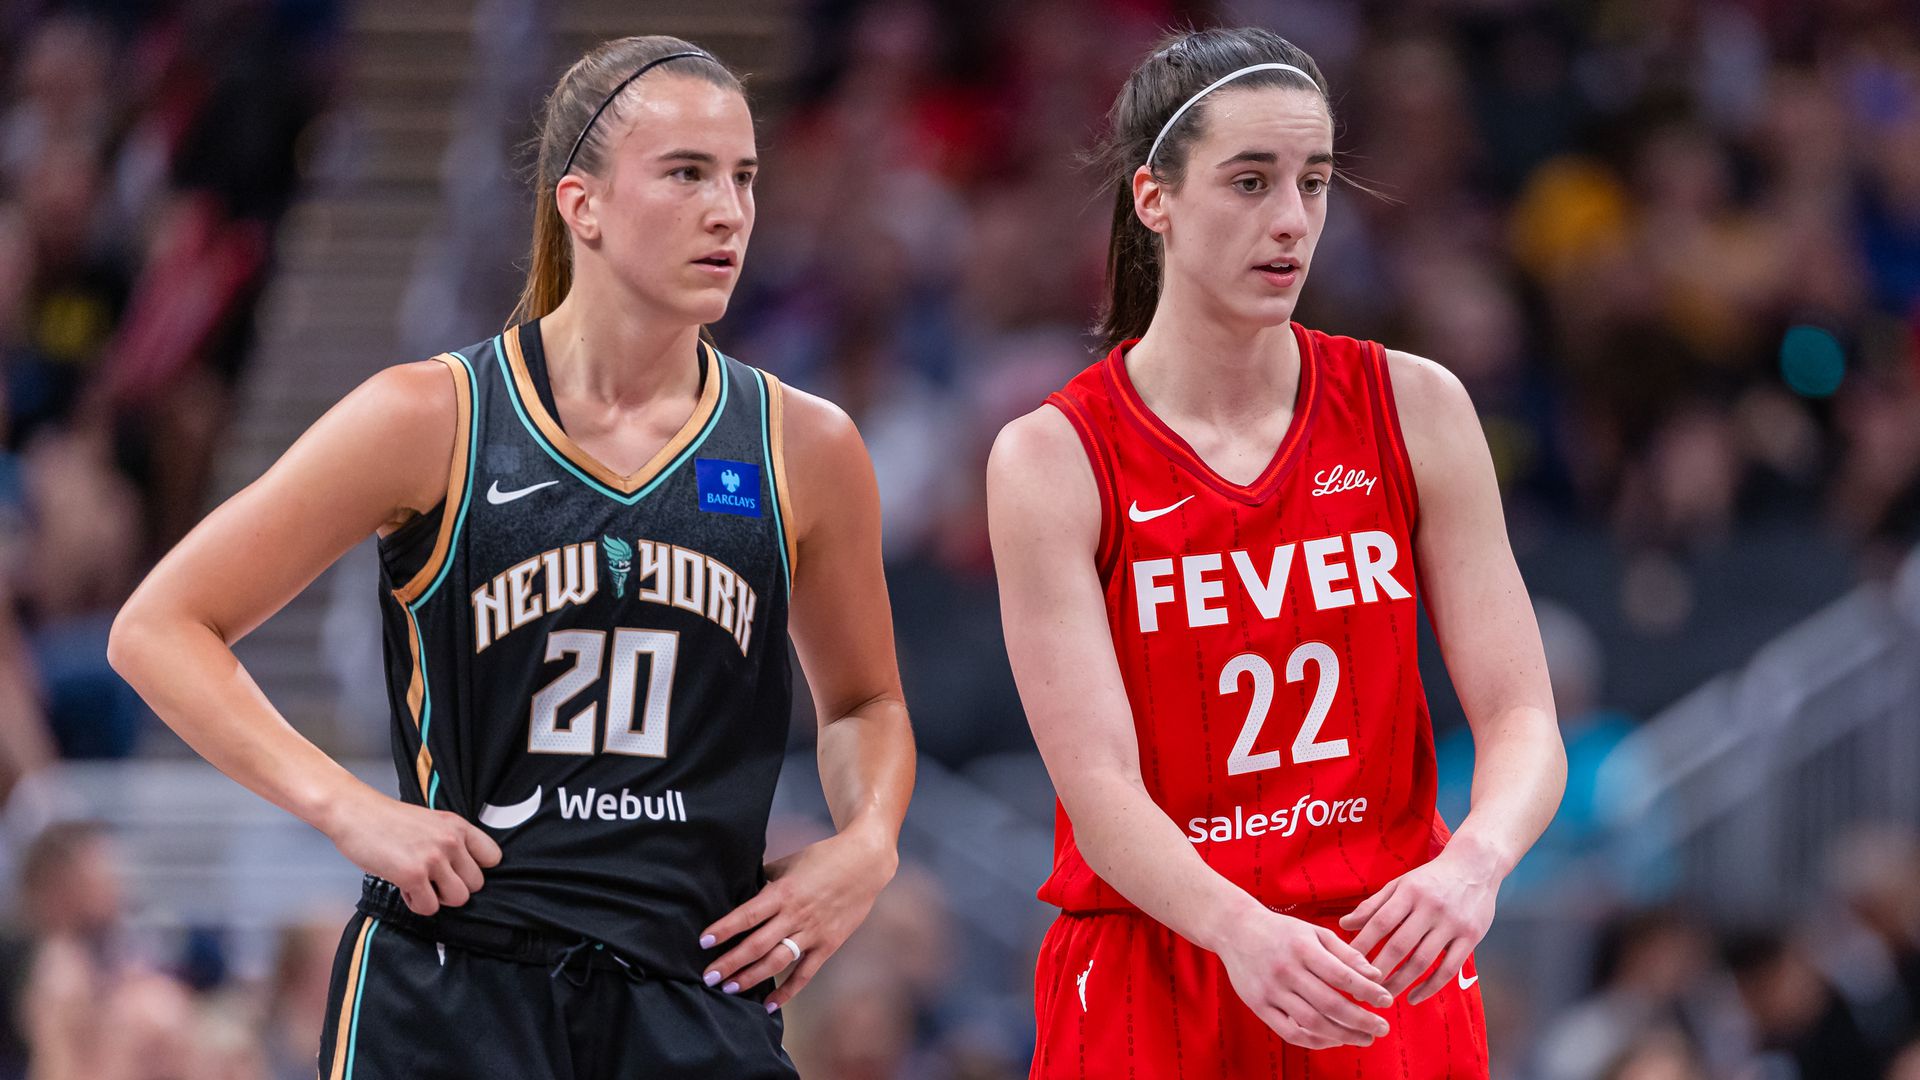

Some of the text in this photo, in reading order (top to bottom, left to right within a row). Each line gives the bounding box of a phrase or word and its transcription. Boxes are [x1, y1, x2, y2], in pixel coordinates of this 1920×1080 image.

[707, 492, 755, 509] BARCLAYS
[1312, 464, 1377, 497] Lilly
[471, 538, 757, 658] NEW YORK
[1132, 530, 1412, 633] FEVER
[527, 626, 680, 758] 20
[1218, 641, 1350, 776] 22
[557, 786, 687, 822] Webull
[1188, 794, 1367, 843] salesforce
